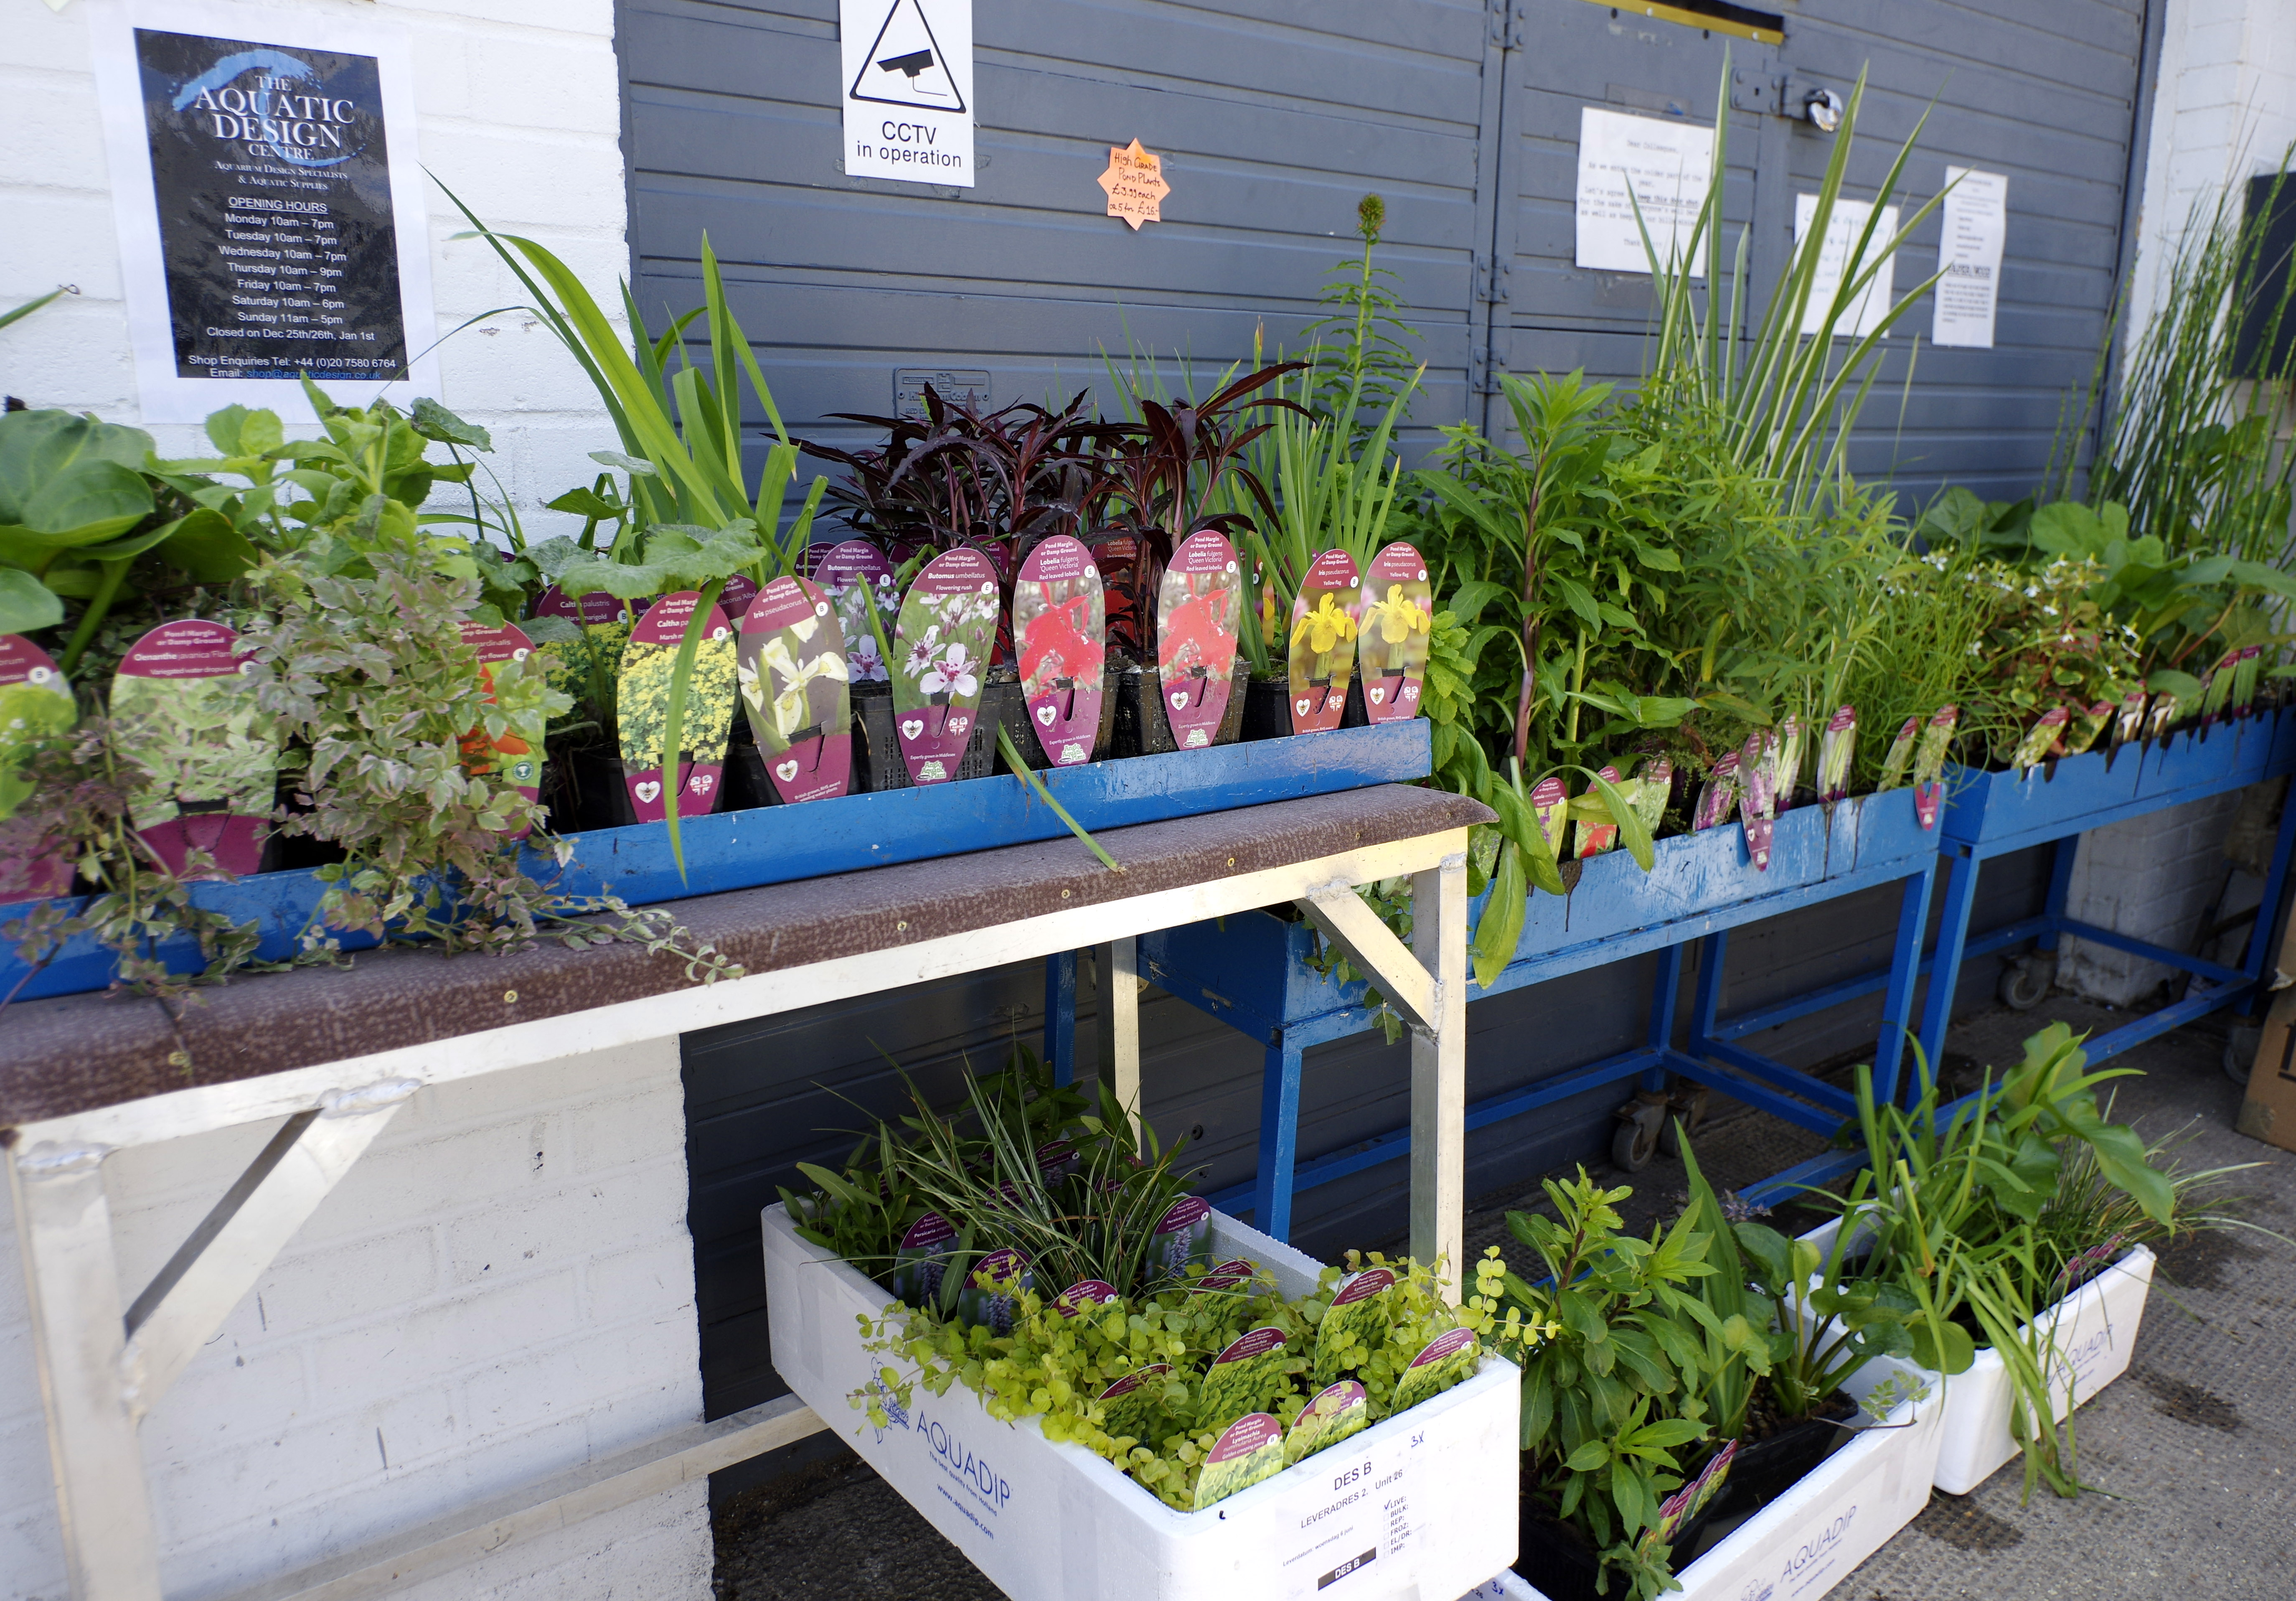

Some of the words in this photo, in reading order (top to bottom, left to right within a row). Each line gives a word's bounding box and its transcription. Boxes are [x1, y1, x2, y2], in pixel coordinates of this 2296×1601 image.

[255, 75, 292, 91] THE
[194, 86, 355, 123] AQUATIC
[213, 114, 341, 148] DESIGN
[882, 121, 937, 145] CCTV
[248, 143, 315, 160] CENTRE
[857, 140, 872, 158] in
[879, 146, 962, 168] operation
[1114, 152, 1132, 166] High
[238, 175, 247, 183] &
[1138, 191, 1156, 200] each
[229, 197, 283, 211] OPENING
[285, 201, 328, 213] HOURS
[1124, 203, 1134, 212] for
[225, 213, 267, 227] Monday
[270, 216, 299, 226] 10am
[311, 219, 334, 230] 7pm
[225, 229, 271, 244] Tuesday
[274, 233, 302, 244] 10am
[314, 234, 337, 247] 7pm
[218, 245, 281, 260] Wednesday
[284, 249, 312, 260] 10am
[324, 251, 346, 262] 7pm
[227, 262, 276, 276] Thursday
[279, 266, 307, 276] 10am
[320, 267, 342, 279] 9pm
[237, 279, 270, 291] Friday
[274, 281, 301, 292] 10am
[314, 283, 336, 294] 7pm
[232, 295, 279, 307] Saturday
[282, 298, 310, 308] 10am
[322, 300, 345, 310] 6pm
[237, 312, 277, 324] Sunday
[281, 313, 308, 324] 11am
[321, 315, 343, 326] 5pm
[206, 327, 245, 338] Closed
[263, 328, 283, 338] Dec
[286, 330, 336, 341] 25th/26th,
[338, 330, 357, 341] Jan
[360, 331, 375, 341] 1st
[189, 356, 218, 368] Shop
[221, 356, 269, 369] Enquiries
[272, 357, 291, 366] Tel:
[294, 358, 313, 367] +44
[316, 358, 343, 369] (0)20
[345, 358, 369, 368] 7580
[371, 358, 396, 368] 6764
[210, 368, 243, 378] Email:
[247, 369, 381, 380] shop@aquticdesign.co.uk
[583, 600, 610, 608] palustris
[765, 600, 802, 617] pseudacorus
[134, 652, 177, 661] Oenanthe
[914, 1229, 936, 1238] Persicaria
[916, 1237, 939, 1246] Amphibious
[1232, 1430, 1260, 1444] Lysimachia
[1222, 1451, 1237, 1459] Golden
[1237, 1445, 1254, 1454] creeping
[1253, 1441, 1265, 1449] jenny
[1223, 1439, 1252, 1453] nummularia
[917, 1410, 1010, 1508] AQUADIP
[1334, 1468, 1359, 1491] DES
[1364, 1461, 1372, 1476] B
[938, 1460, 948, 1473] best
[949, 1469, 965, 1489] quality
[966, 1484, 978, 1499] from
[978, 1495, 997, 1517] Holland
[1301, 1492, 1359, 1529] LEVERADRES
[1362, 1488, 1368, 1497] 2.
[1376, 1476, 1392, 1489] Unit
[1394, 1470, 1402, 1480] 26
[1390, 1496, 1407, 1508] LIVE:
[937, 1483, 993, 1540] www.aquadip.com
[1390, 1504, 1408, 1517] BULK:
[1390, 1515, 1404, 1527] REP:
[1390, 1522, 1409, 1536] FROZ:
[1390, 1530, 1412, 1545] EL/DR:
[1780, 1505, 1856, 1583] AQUADIP
[1283, 1548, 1314, 1567] Leverdatum:
[1315, 1533, 1339, 1550] woensdag
[1344, 1525, 1354, 1535] juni
[1391, 1543, 1405, 1555] IMP:
[1335, 1562, 1352, 1579] DES
[1354, 1558, 1360, 1567] B
